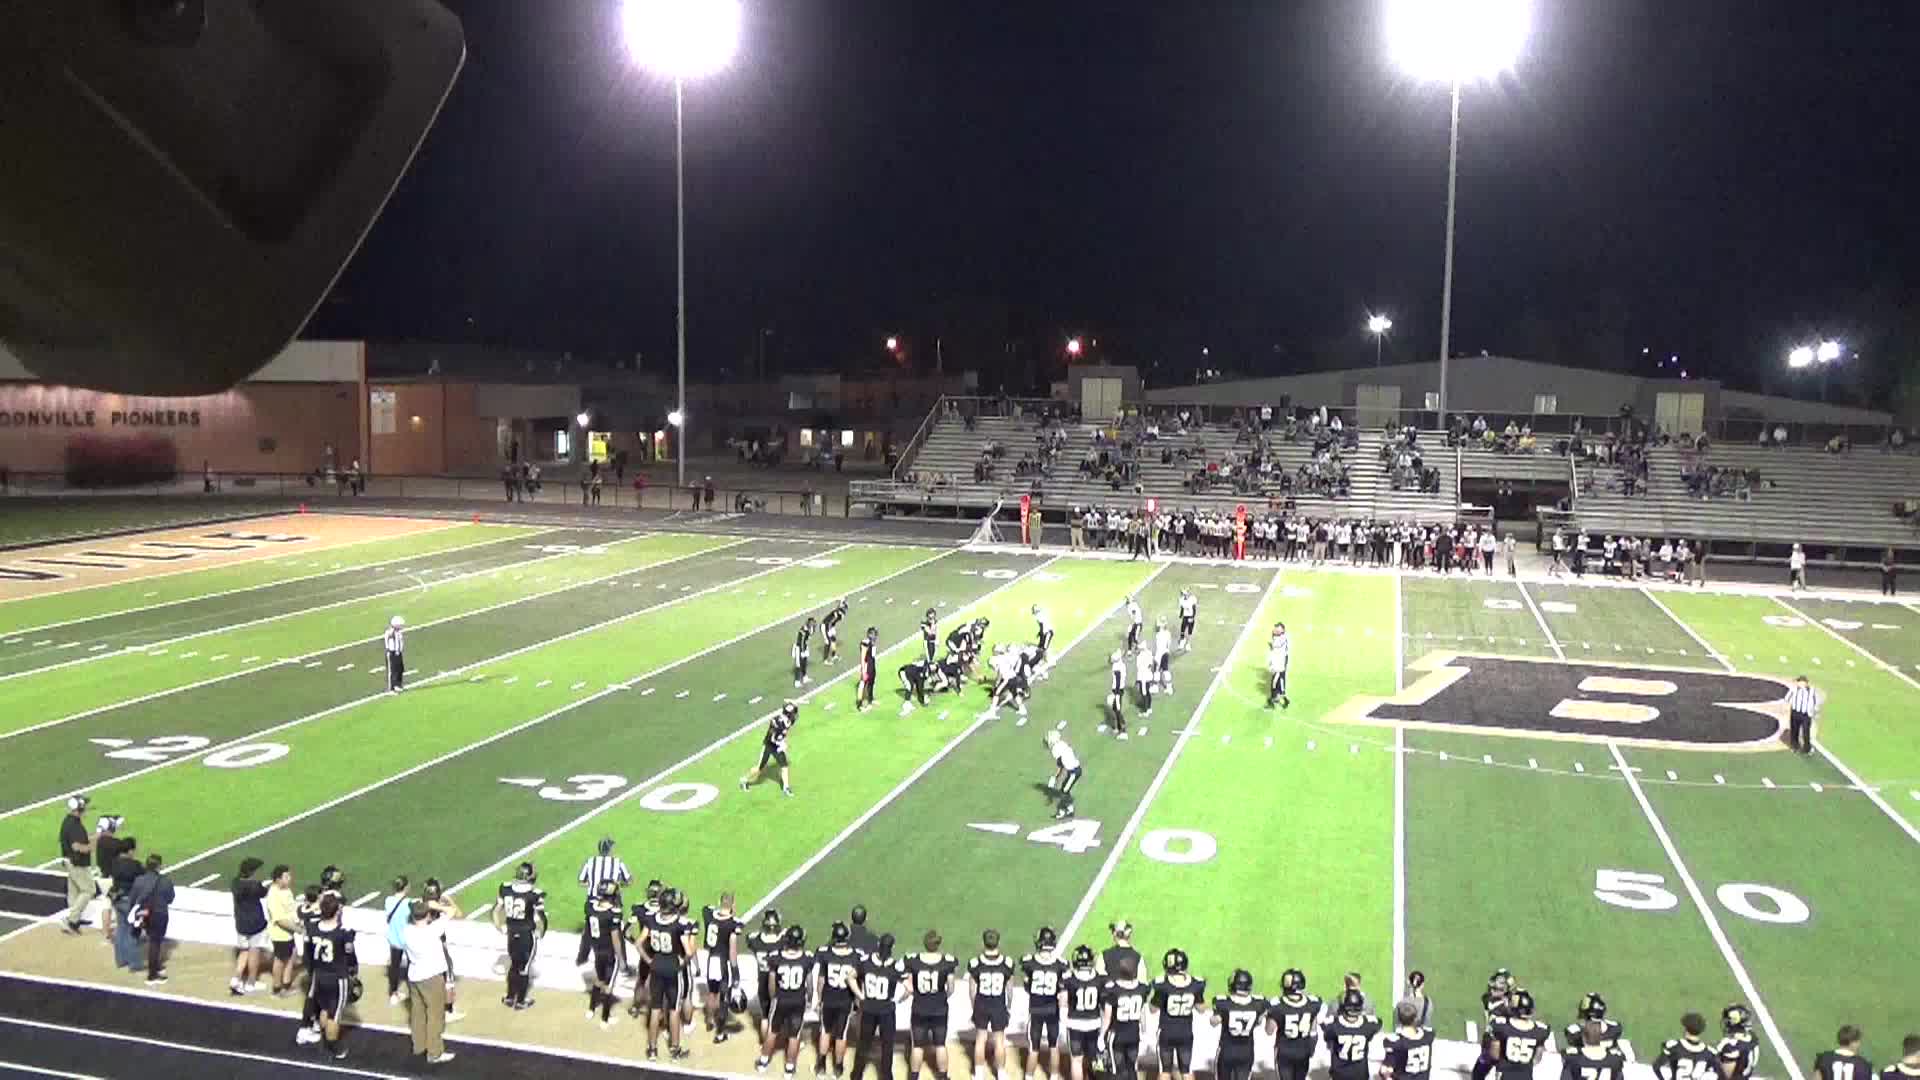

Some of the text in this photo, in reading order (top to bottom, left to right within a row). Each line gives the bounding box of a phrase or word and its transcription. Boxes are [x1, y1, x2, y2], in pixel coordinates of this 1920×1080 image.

[111, 411, 200, 426] PIONEERS
[104, 736, 290, 768] 20
[538, 774, 719, 810] 30
[1026, 819, 1217, 863] 40
[1593, 869, 1810, 923] 50
[312, 936, 335, 963] 73
[777, 964, 804, 990] 30
[865, 973, 889, 1000] 60
[917, 970, 940, 993] 61
[1075, 986, 1098, 1011] 10
[1117, 995, 1143, 1022] 20
[1229, 1011, 1257, 1036] 57
[1284, 1013, 1311, 1038] 54
[1338, 1035, 1368, 1061] 72
[1505, 1037, 1537, 1064] 65
